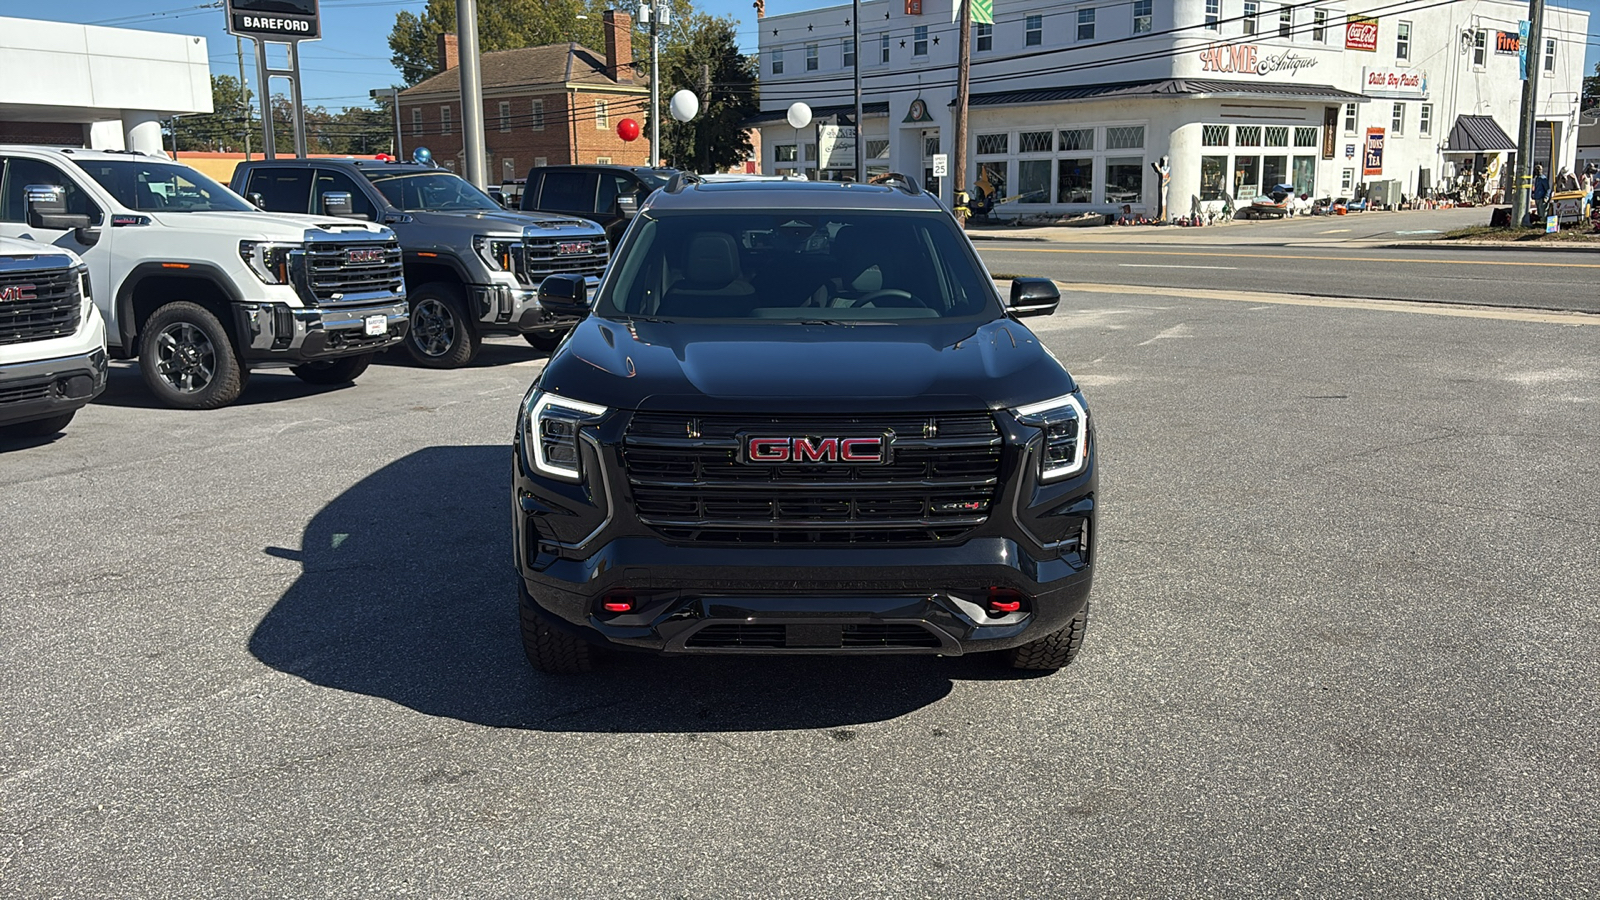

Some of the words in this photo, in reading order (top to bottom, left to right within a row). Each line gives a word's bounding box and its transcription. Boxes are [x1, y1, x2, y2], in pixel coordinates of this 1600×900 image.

[243, 16, 309, 32] BAREFORD
[1199, 42, 1258, 74] ACME
[1272, 48, 1318, 77] Antiques
[1368, 72, 1386, 85] Dutch
[1388, 73, 1400, 89] Boy
[1400, 73, 1419, 87] Paints
[1368, 154, 1380, 166] TEA
[935, 165, 945, 173] 25
[750, 437, 882, 462] GMC
